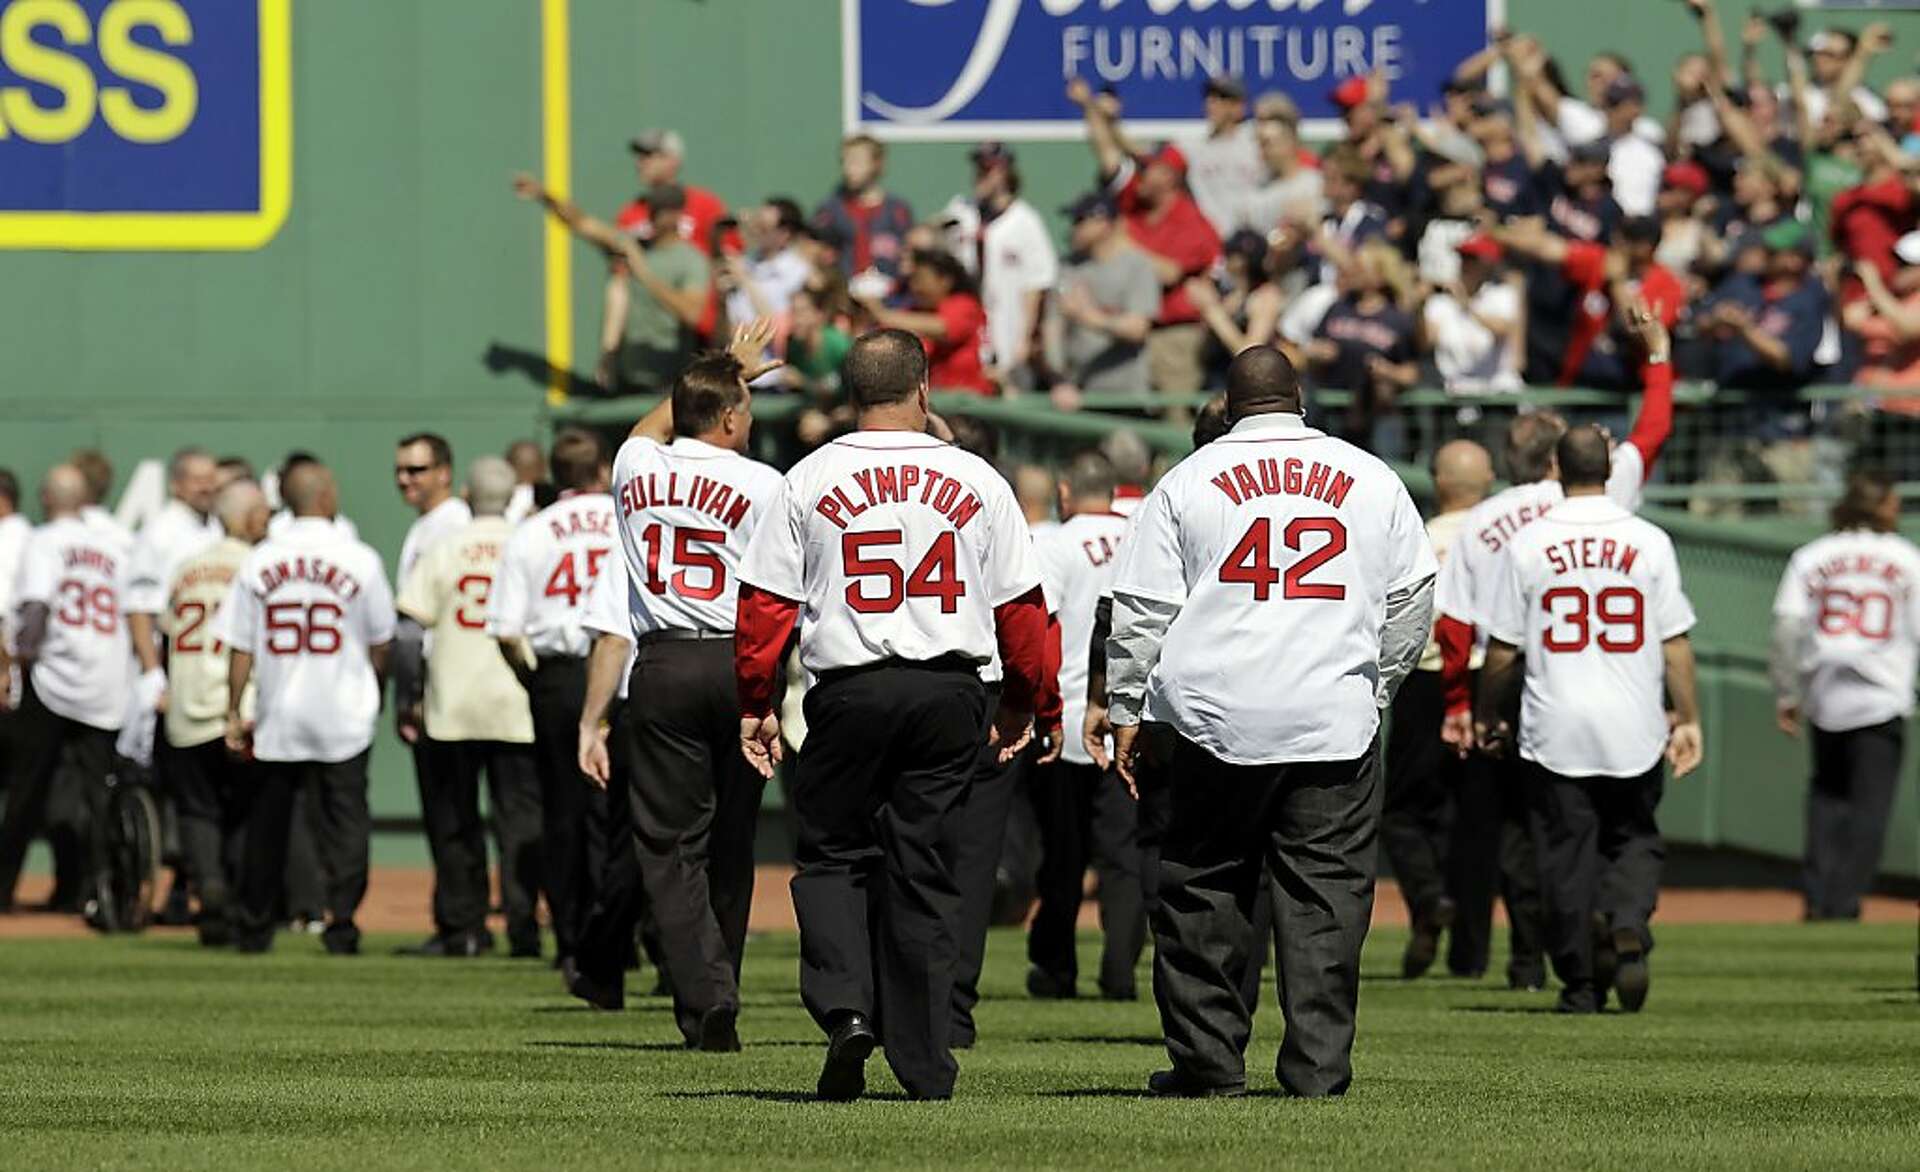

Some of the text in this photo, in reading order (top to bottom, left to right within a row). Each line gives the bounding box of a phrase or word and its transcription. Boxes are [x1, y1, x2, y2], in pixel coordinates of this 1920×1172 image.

[0, 0, 199, 144] SS
[1062, 25, 1403, 81] FURNITURE
[620, 472, 751, 530] SULLIVAN
[815, 465, 983, 531] PLYMPTON
[1210, 458, 1355, 509] VAUGHN
[641, 523, 726, 602] 15
[842, 529, 966, 614] 54
[1083, 536, 1121, 567] CA
[1218, 517, 1347, 600] 42
[1545, 538, 1639, 575] STERN
[58, 579, 117, 636] 39
[266, 602, 343, 656] 56
[1541, 586, 1645, 654] 39
